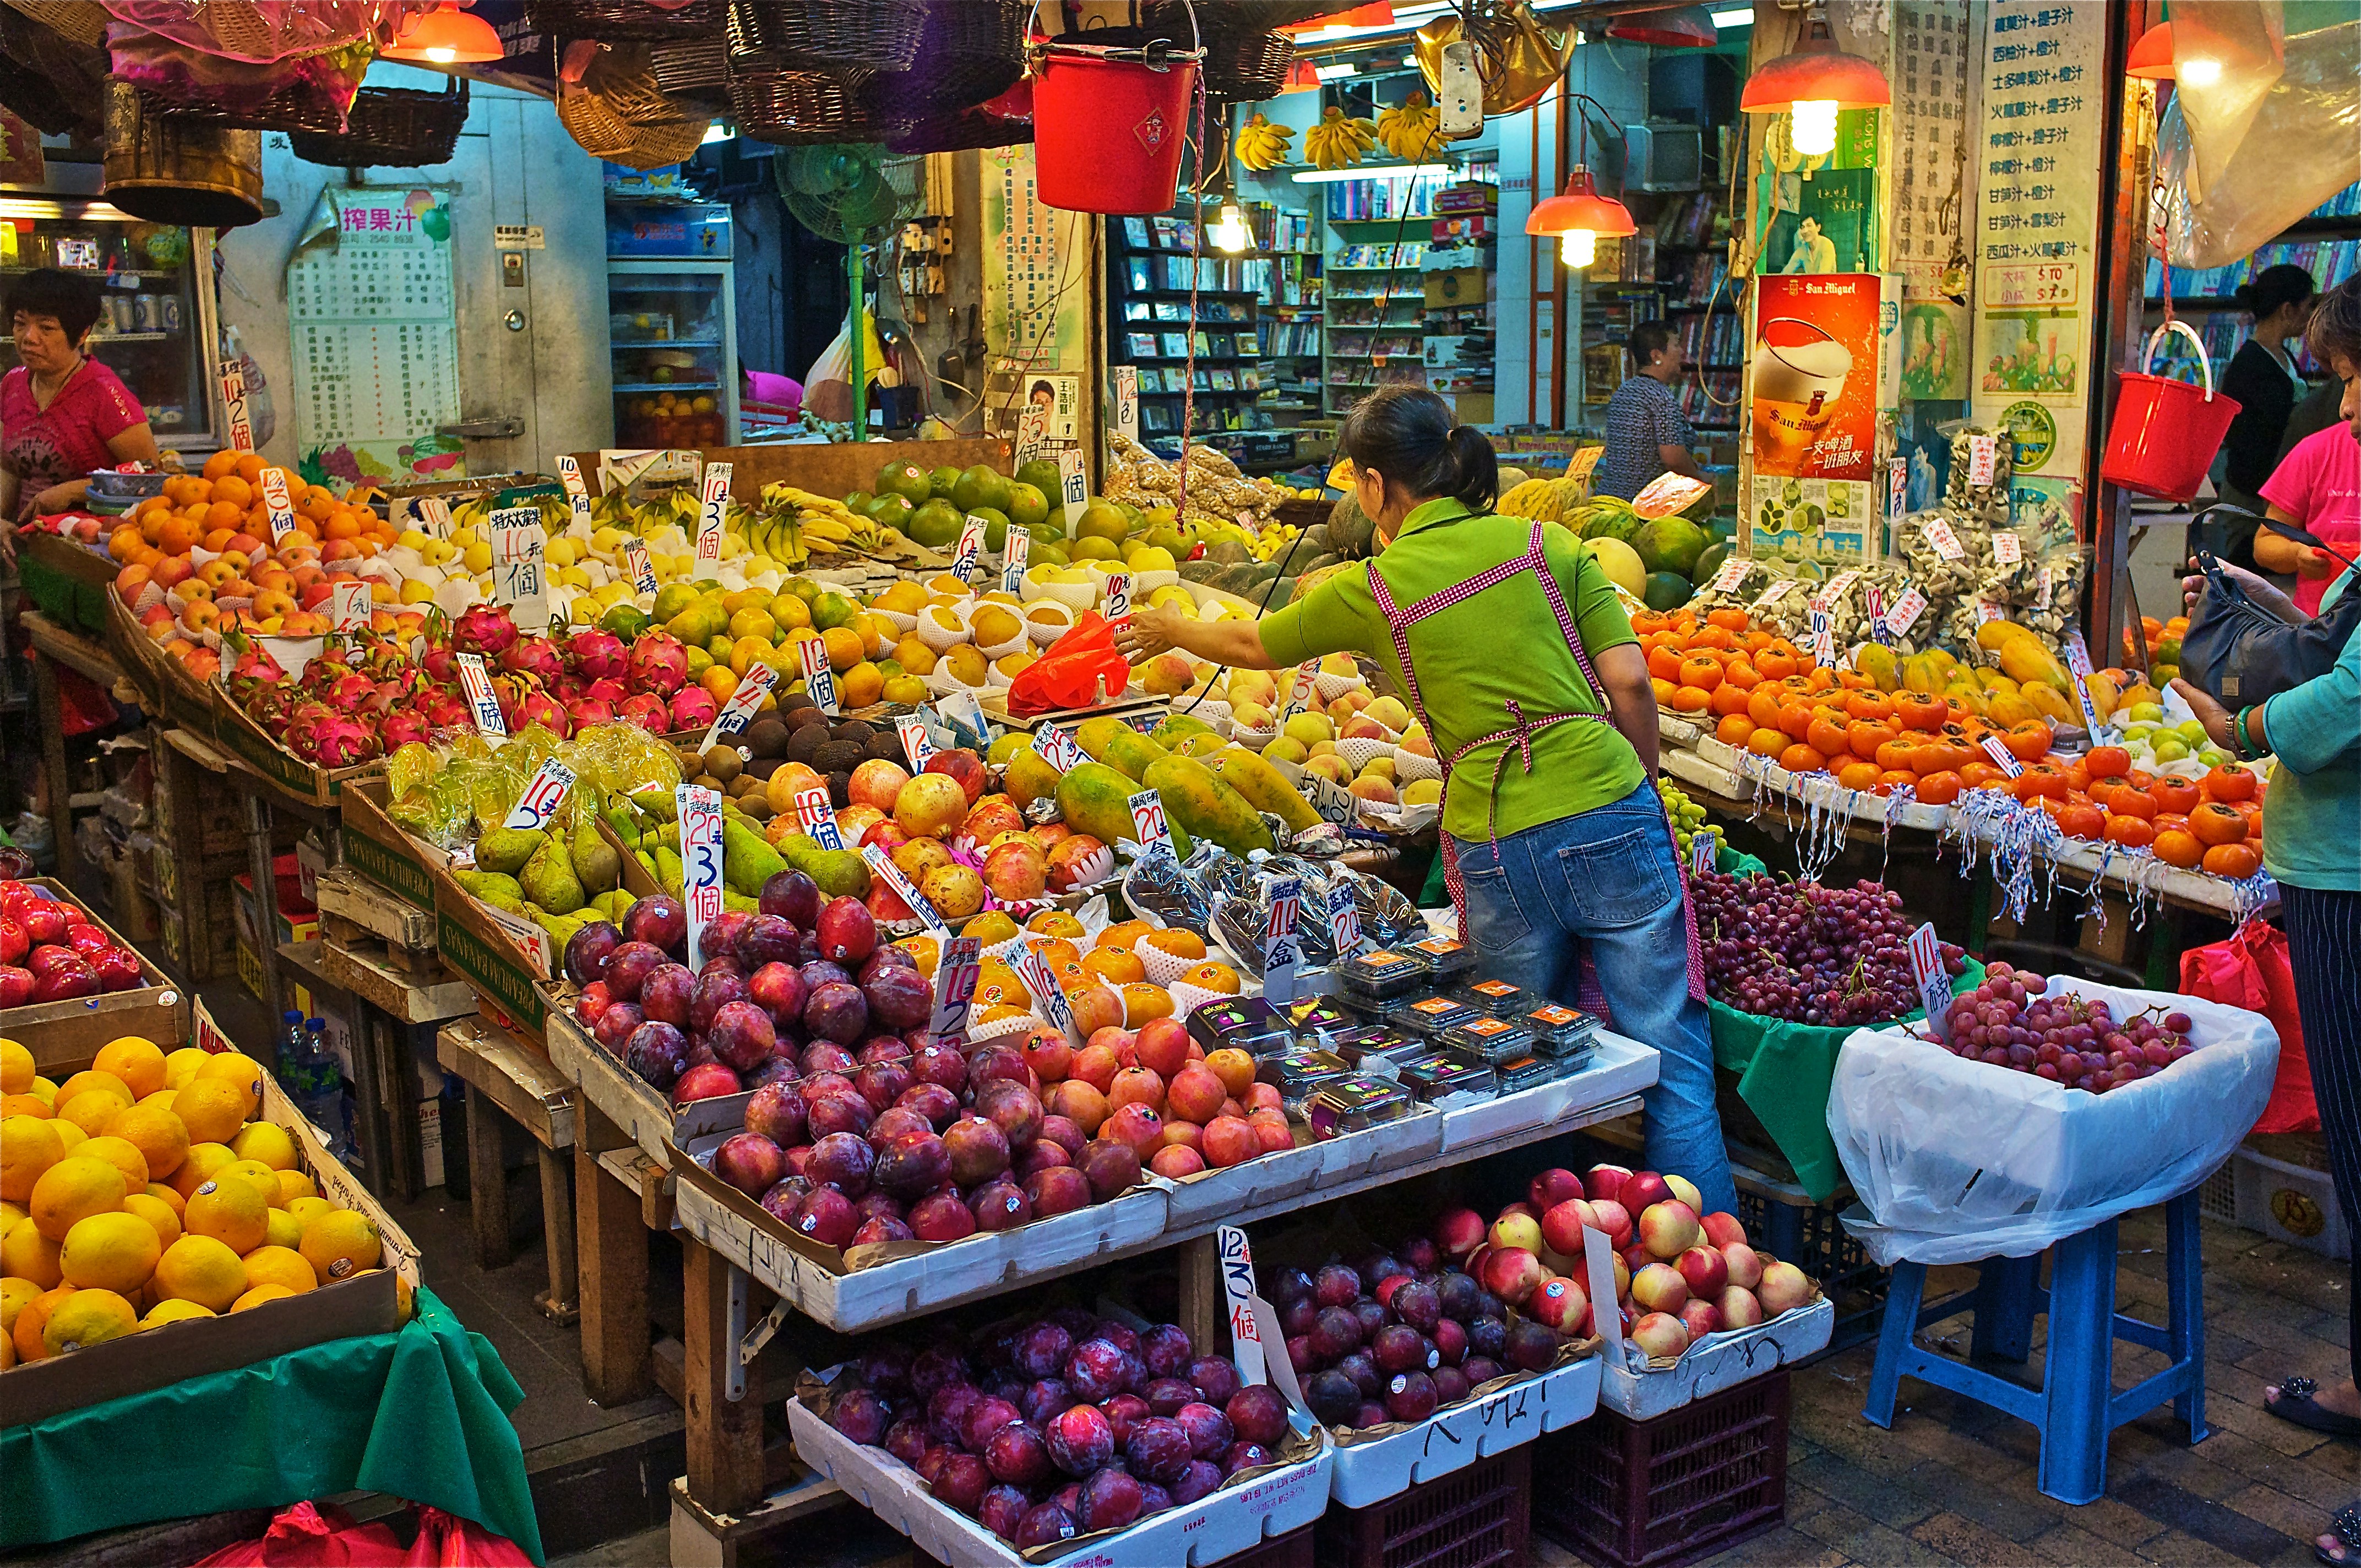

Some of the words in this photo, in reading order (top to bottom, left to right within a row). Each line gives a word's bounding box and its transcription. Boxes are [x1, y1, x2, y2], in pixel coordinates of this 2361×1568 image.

[1805, 282, 1823, 293] San
[1824, 282, 1856, 295] Miguel
[1120, 378, 1138, 400] 12元
[229, 399, 246, 424] 2
[1769, 410, 1794, 429] San
[230, 424, 251, 451] 個
[1802, 434, 1854, 456] 一支啤酒
[1060, 451, 1085, 477] 20元
[565, 472, 585, 493] 3
[705, 479, 727, 503] 10元
[1062, 475, 1084, 504] 個
[266, 488, 289, 510] 3
[572, 495, 591, 514] 個
[270, 512, 295, 531] 個
[706, 502, 720, 532] 3
[505, 529, 542, 563] 10元
[699, 532, 719, 560] 個
[960, 528, 978, 559] 6元
[1008, 536, 1027, 563] 10元
[629, 547, 653, 578] 12元
[952, 556, 974, 584] 個
[503, 563, 539, 600] 個
[1004, 562, 1025, 594] 個
[1107, 575, 1130, 596] 10元
[342, 583, 369, 613] 7元
[1108, 594, 1128, 617] 2
[800, 636, 829, 676] 10元
[1815, 634, 1832, 656] 4
[464, 666, 494, 699] 10元
[746, 664, 776, 690] 10元
[807, 671, 837, 710] 個
[1292, 673, 1315, 700] 3
[733, 685, 761, 711] 4
[477, 698, 503, 731] 磅
[717, 709, 750, 736] 個
[902, 726, 933, 762] 12元
[523, 773, 564, 817] 10元
[797, 791, 833, 826] 10元
[690, 812, 723, 846] 20元
[810, 822, 844, 851] 個
[1135, 805, 1169, 845] 20元
[697, 846, 717, 888] 3
[690, 882, 721, 924] 個
[1269, 899, 1299, 938] 40元
[1334, 910, 1363, 952] 20元
[1266, 939, 1296, 972] 盒
[938, 1000, 967, 1039] 2
[1221, 1229, 1250, 1262] 12元
[1225, 1261, 1253, 1300] 3
[1231, 1304, 1261, 1342] 個
